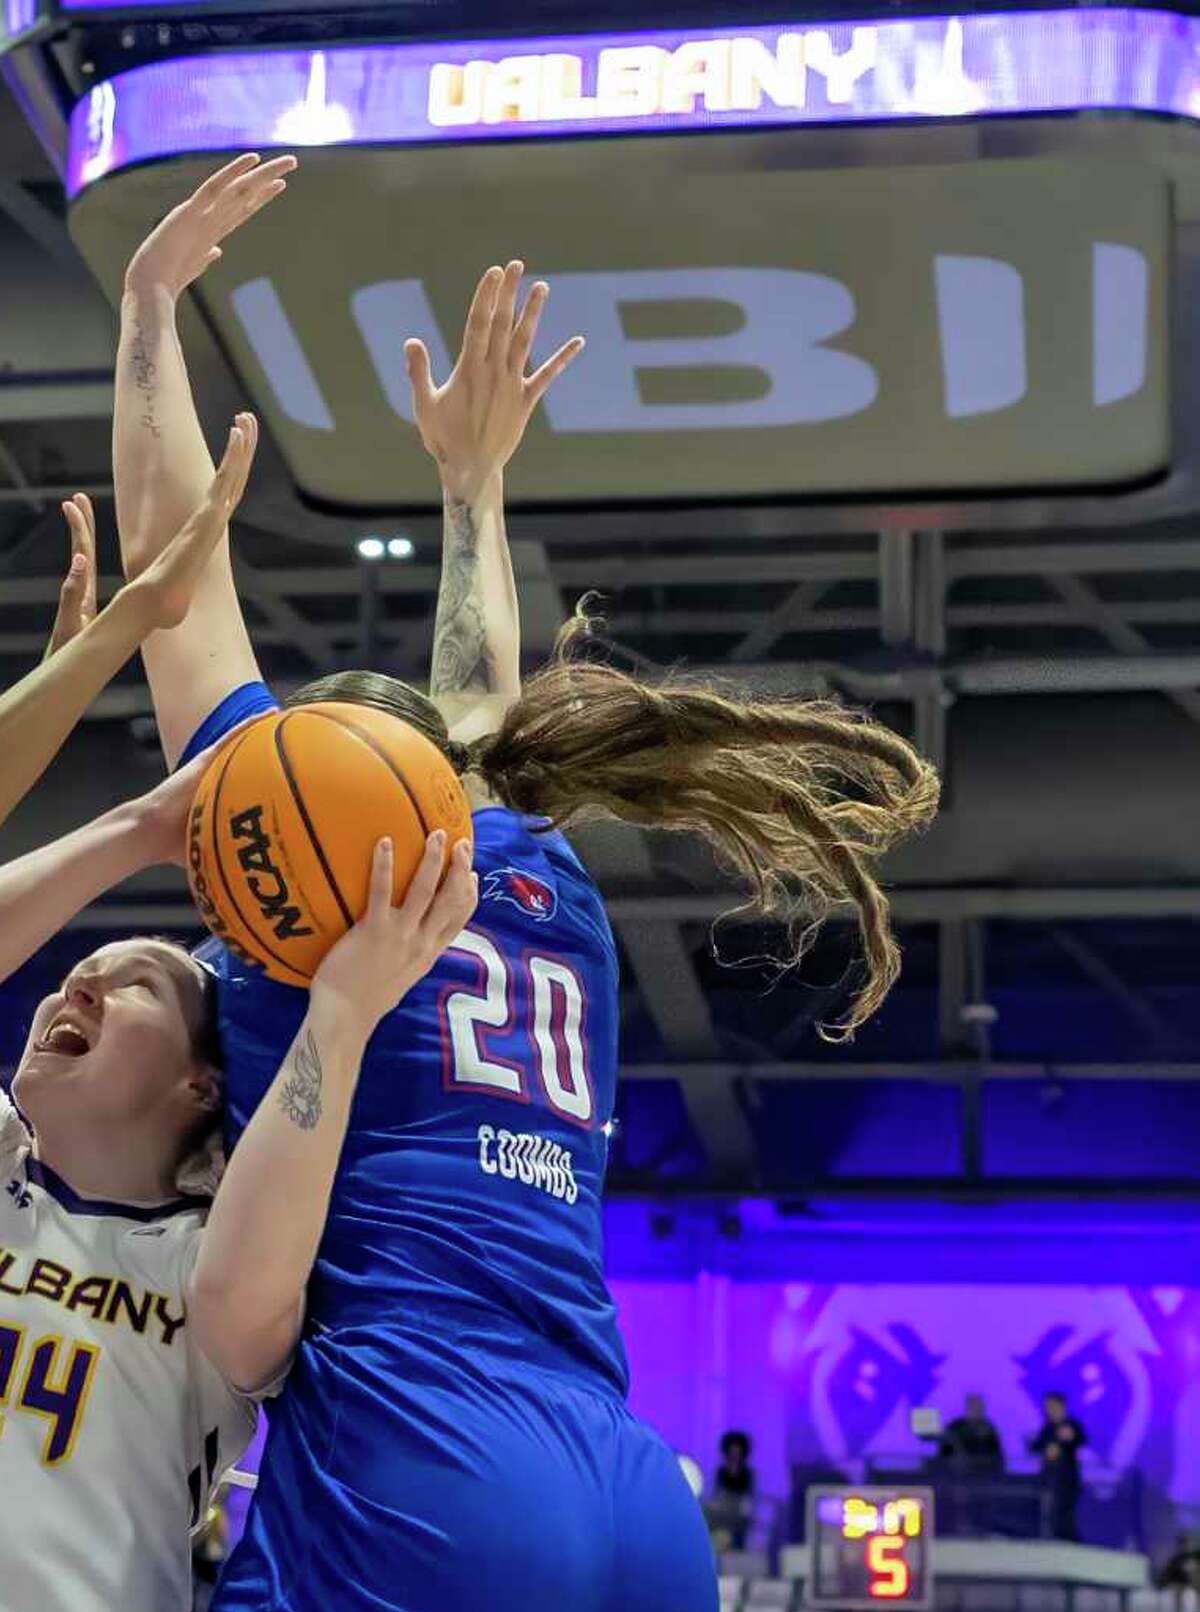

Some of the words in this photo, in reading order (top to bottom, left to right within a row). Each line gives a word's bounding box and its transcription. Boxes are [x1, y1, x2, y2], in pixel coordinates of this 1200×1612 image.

[428, 26, 877, 126] UALBANY
[230, 804, 315, 941] NCAA
[441, 926, 593, 1132] 20
[478, 1124, 578, 1206] COOMBS
[866, 1535, 910, 1598] 5
